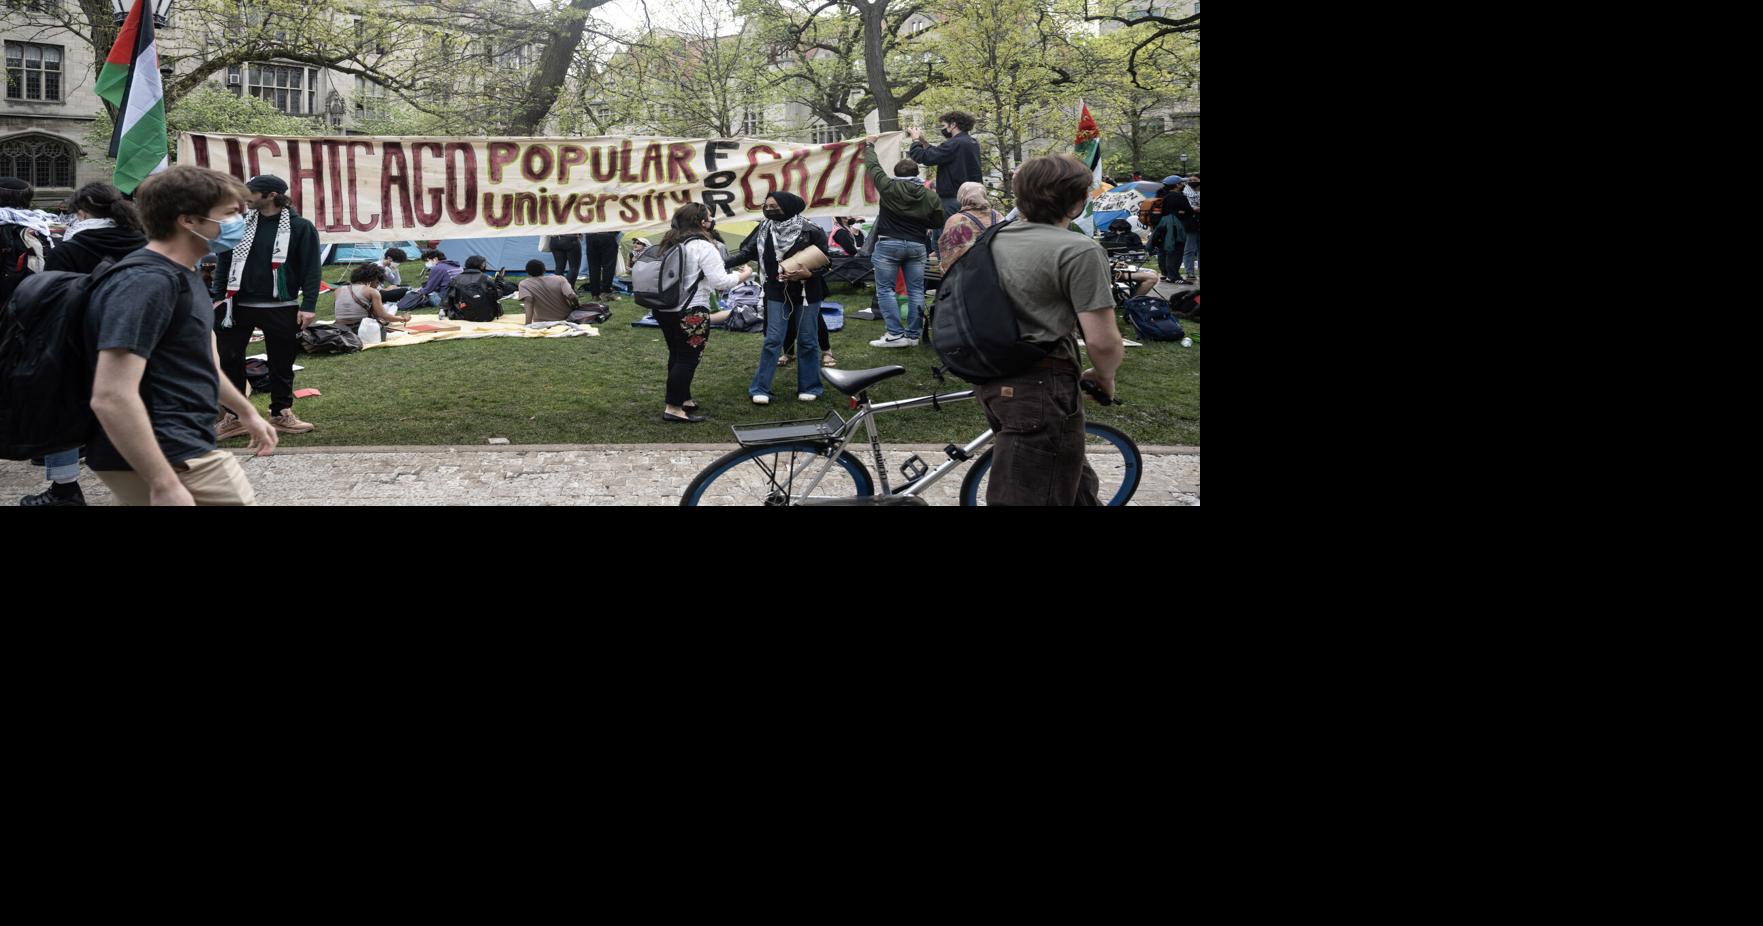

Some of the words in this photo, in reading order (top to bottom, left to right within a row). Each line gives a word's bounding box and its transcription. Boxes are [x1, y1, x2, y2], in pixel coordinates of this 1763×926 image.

[486, 140, 699, 184] POPULAR
[702, 140, 740, 217] FOR
[741, 141, 878, 211] GAZA
